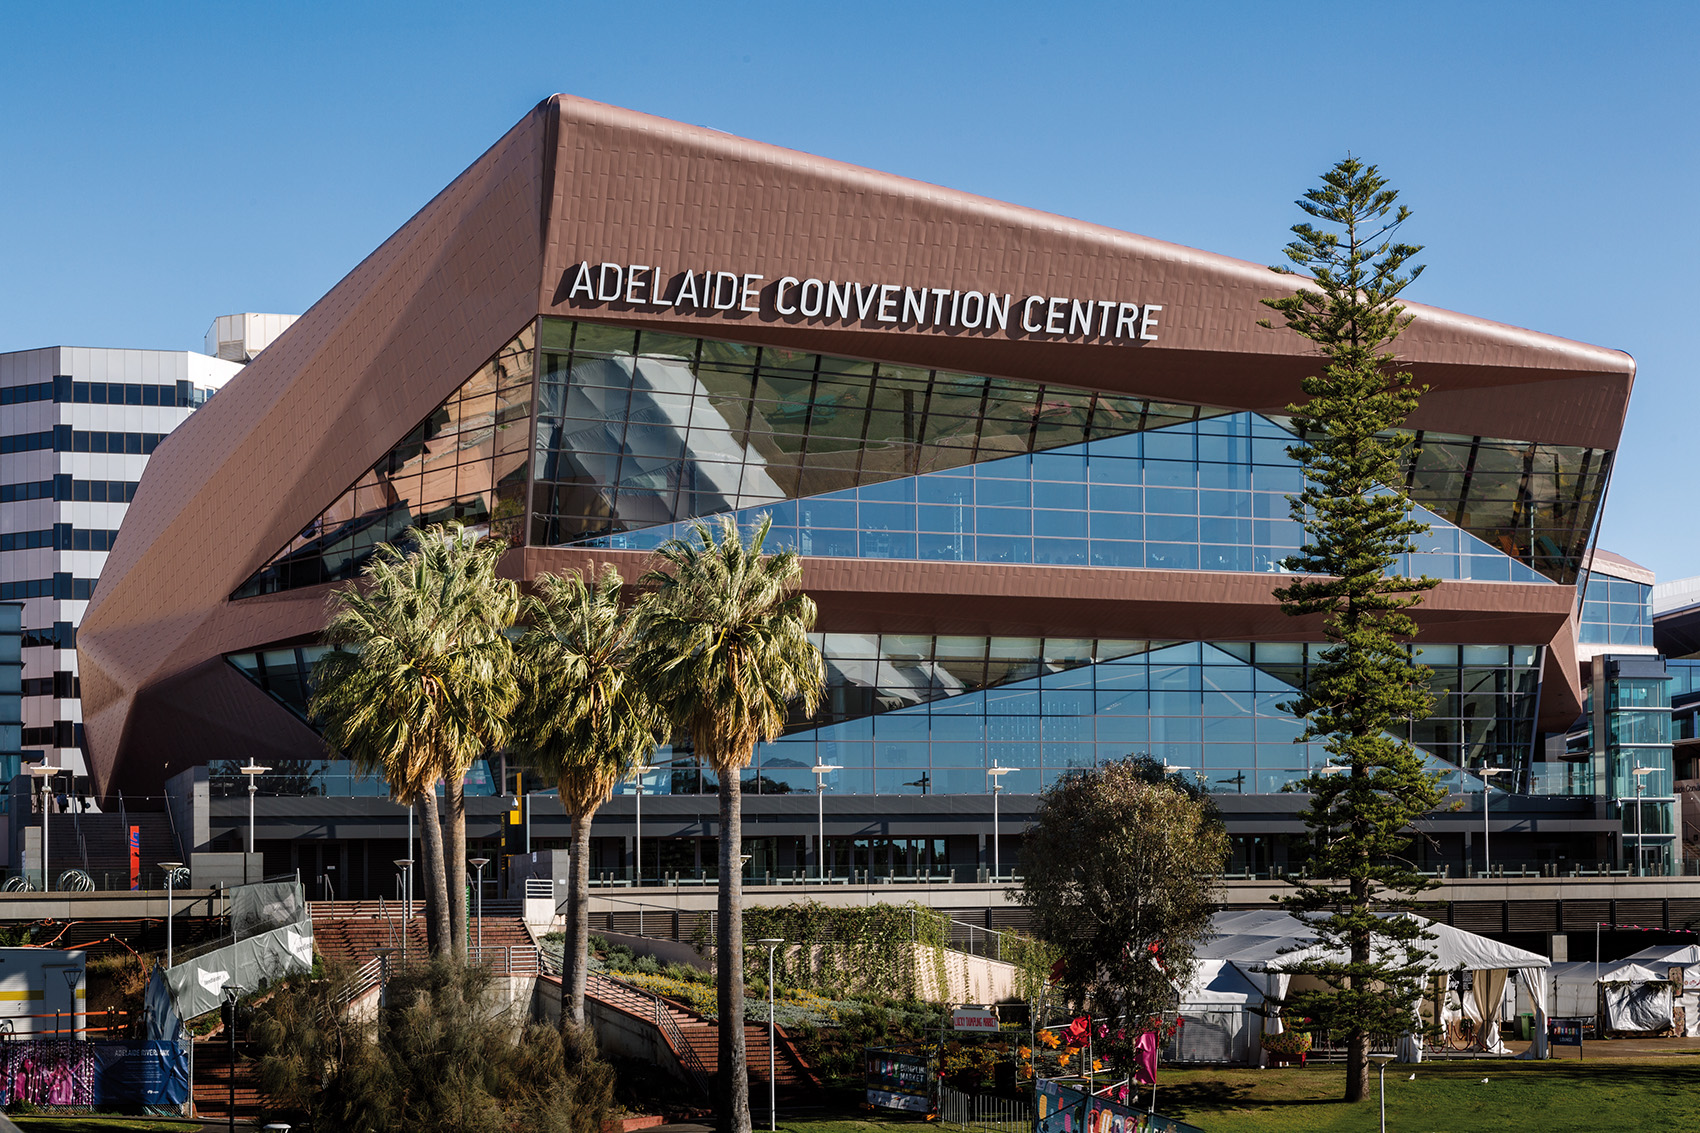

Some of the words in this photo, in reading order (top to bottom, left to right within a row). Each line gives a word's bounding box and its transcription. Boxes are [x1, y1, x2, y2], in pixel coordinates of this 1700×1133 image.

[569, 260, 764, 313] ADELAIDE
[776, 276, 1011, 330] CONVENTION
[1023, 295, 1164, 341] CENTRE
[954, 1016, 965, 1027] LUCKY
[965, 1016, 983, 1027] DUMPLING
[983, 1017, 996, 1027] MARKET
[115, 1049, 140, 1057] ADELAIDE
[869, 1059, 899, 1076] LUCKY
[900, 1072, 924, 1082] MARKET
